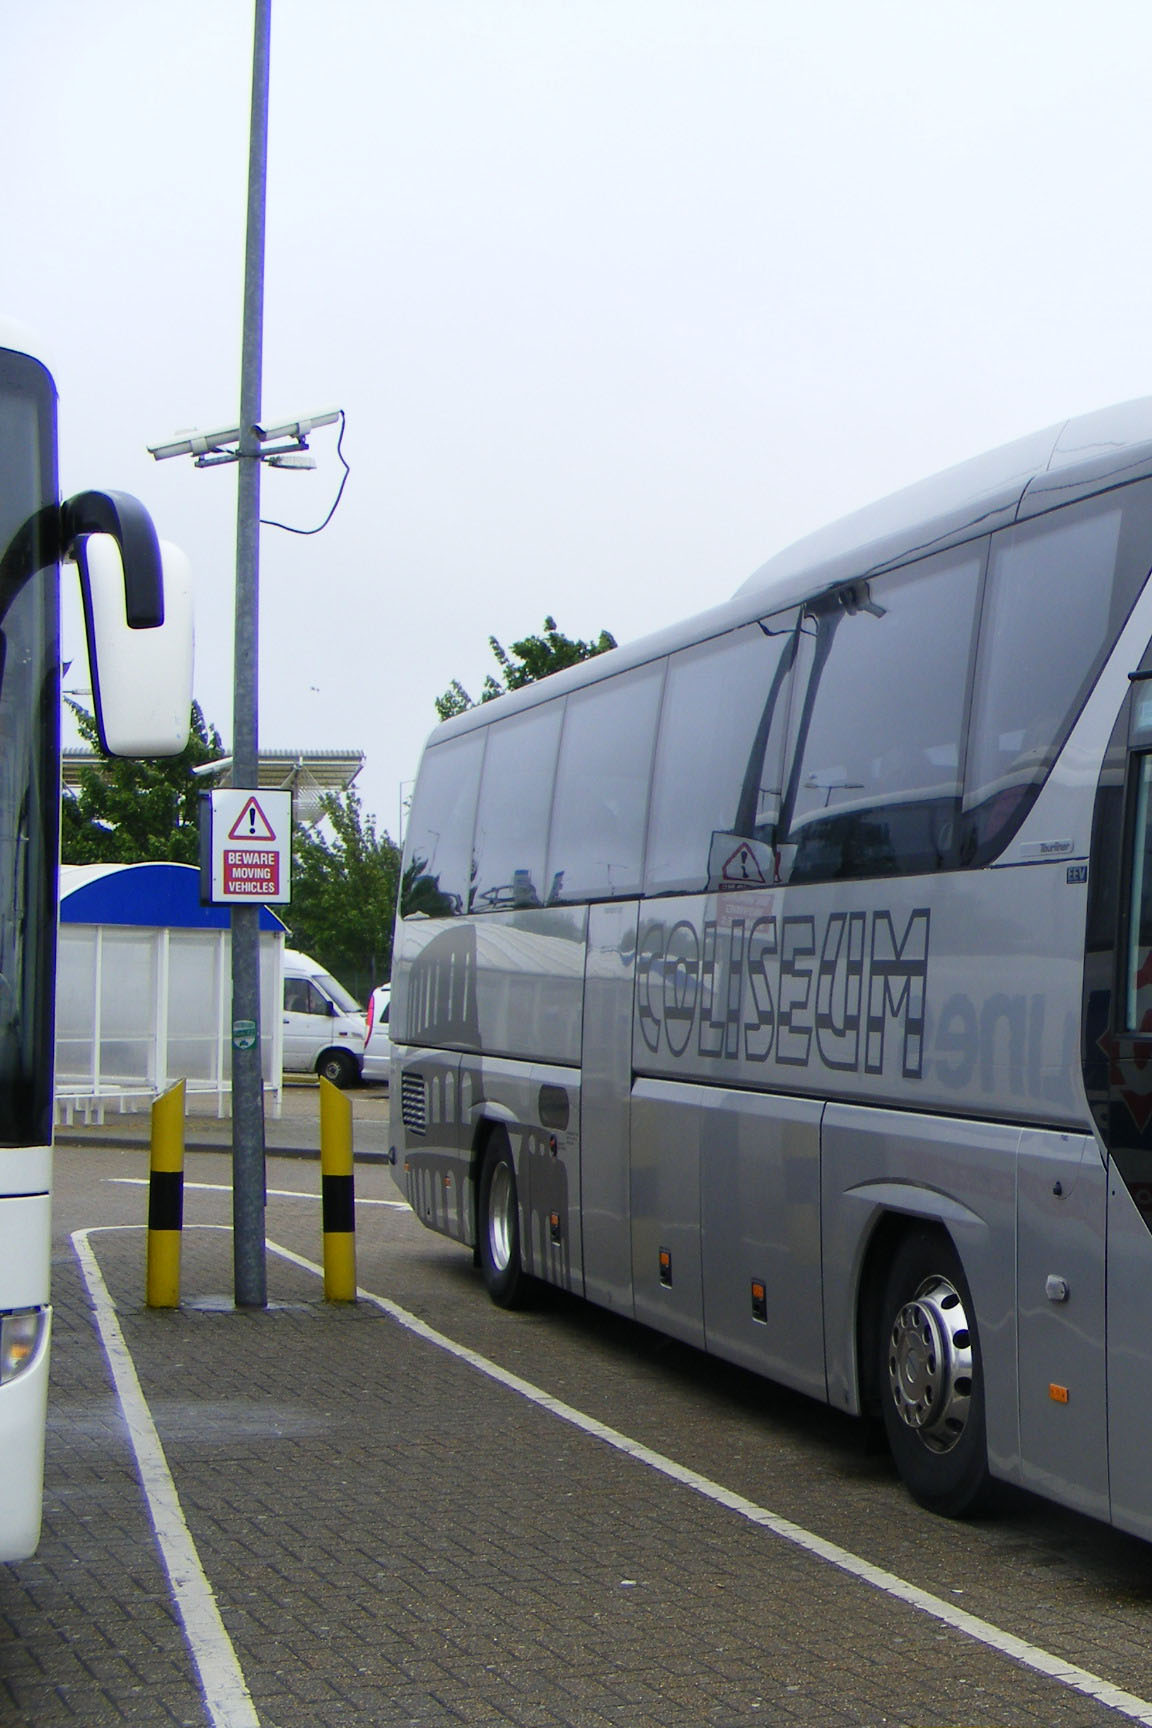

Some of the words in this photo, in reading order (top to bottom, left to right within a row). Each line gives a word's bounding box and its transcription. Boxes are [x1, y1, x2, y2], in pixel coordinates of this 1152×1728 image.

[228, 852, 275, 865] BEWARE
[232, 867, 271, 879] MOVING
[228, 881, 275, 893] VEHICLES
[638, 908, 931, 1079] COLISEUM
